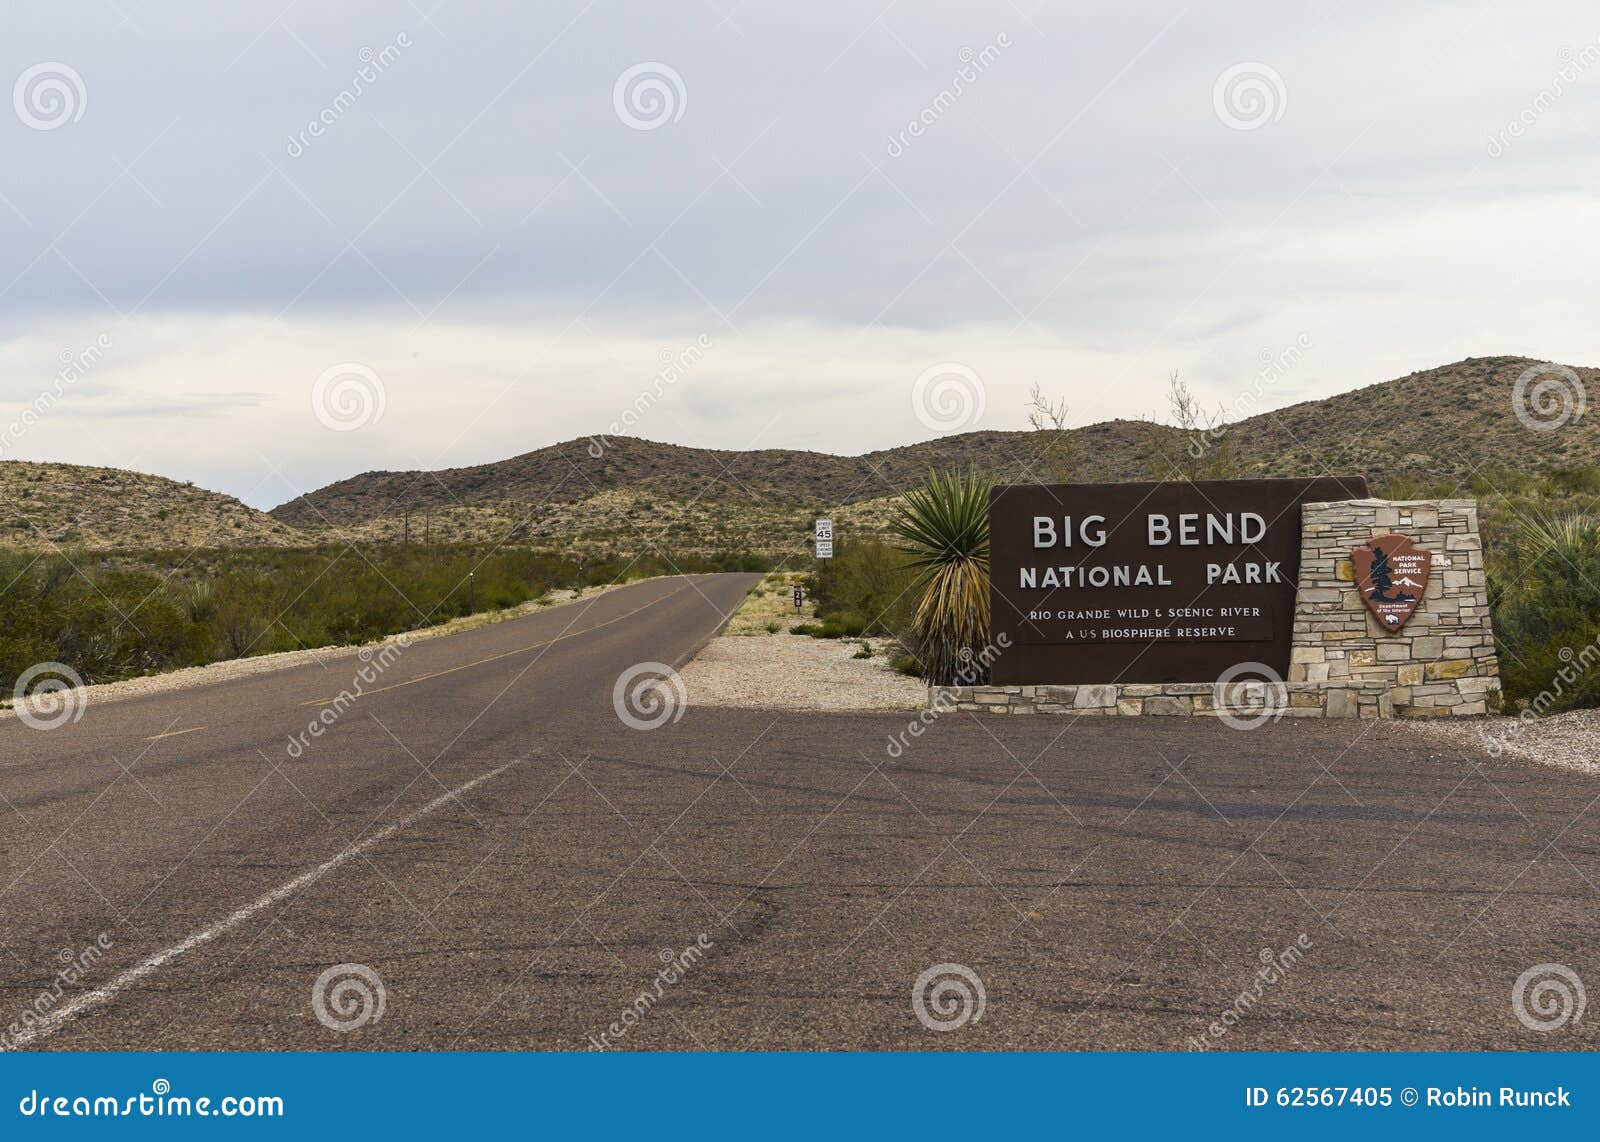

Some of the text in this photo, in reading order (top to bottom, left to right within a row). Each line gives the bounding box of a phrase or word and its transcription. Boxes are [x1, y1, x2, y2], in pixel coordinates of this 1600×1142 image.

[817, 530, 831, 538] 45
[1033, 512, 1266, 548] BIG BEND
[1020, 562, 1282, 588] NATIONAL PARK
[1030, 611, 1052, 620] RIO
[1058, 609, 1111, 620] GRANDE
[1117, 608, 1150, 619] WILD
[1168, 607, 1214, 618] SCENIC
[1220, 607, 1260, 617] RIVER
[1066, 627, 1236, 639] A US BIOSPHERE RESERVE
